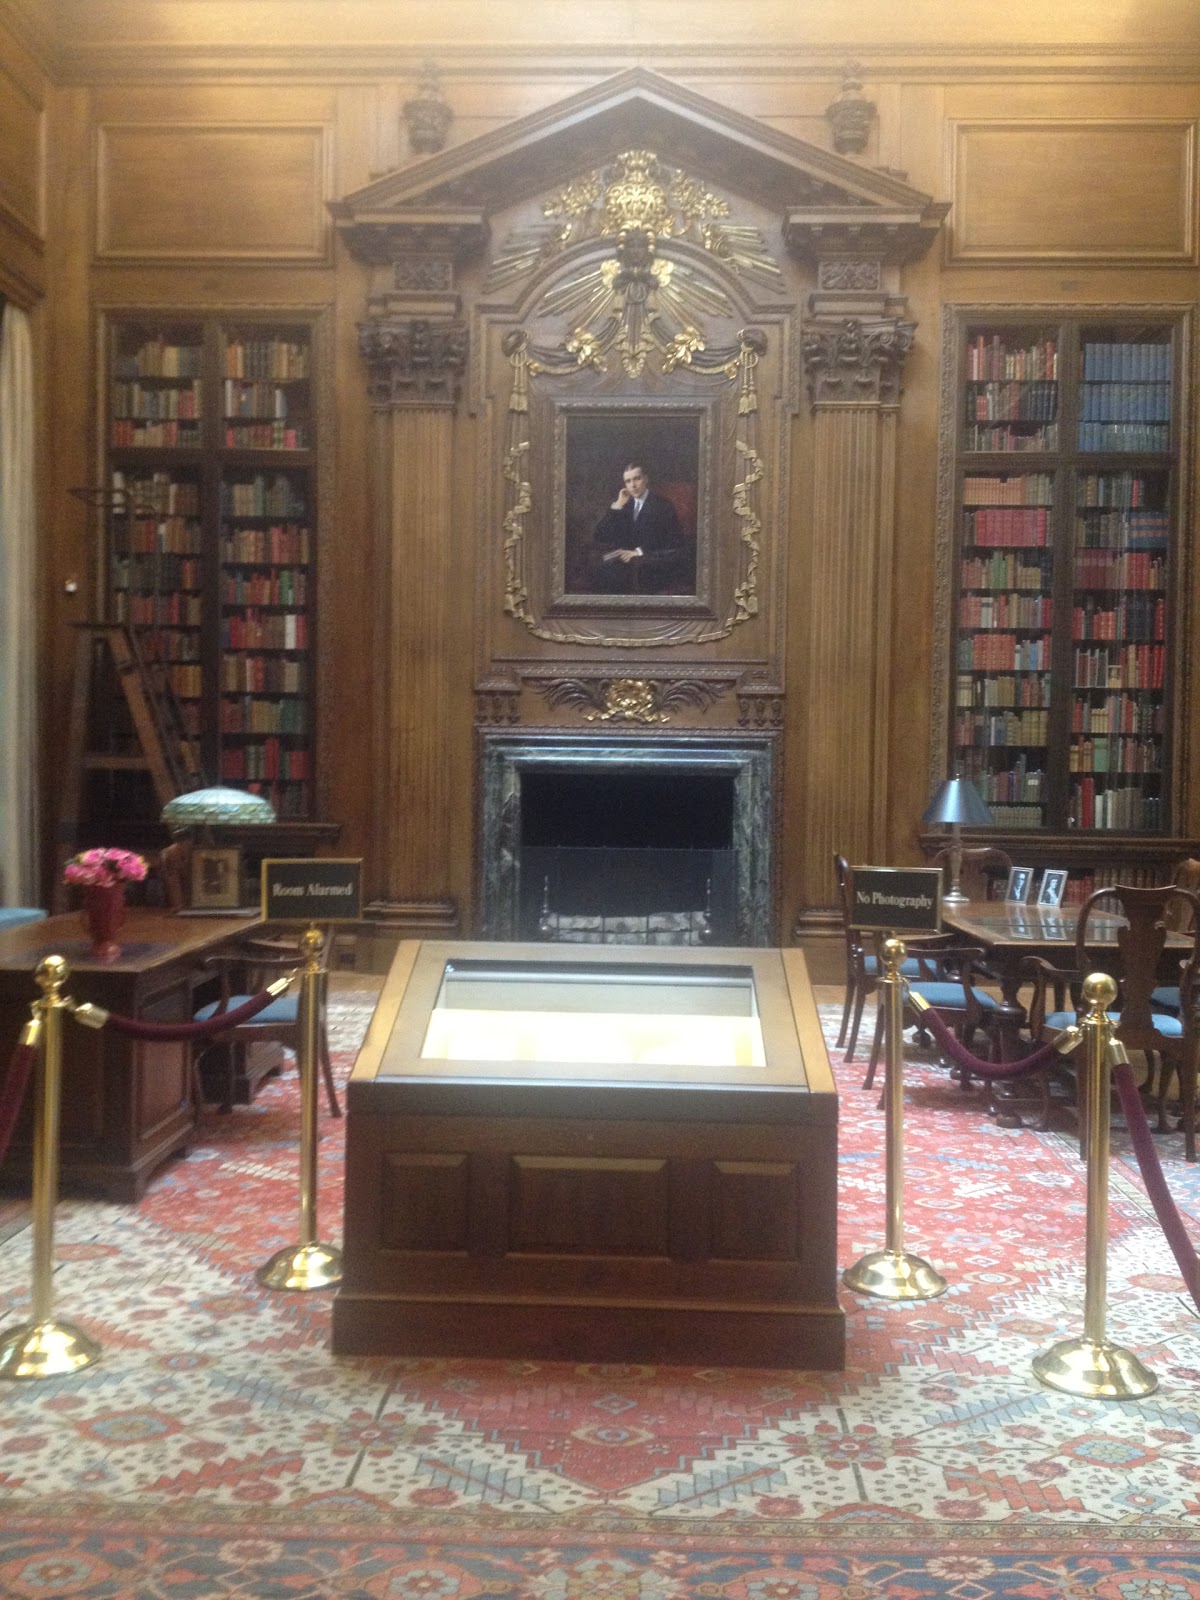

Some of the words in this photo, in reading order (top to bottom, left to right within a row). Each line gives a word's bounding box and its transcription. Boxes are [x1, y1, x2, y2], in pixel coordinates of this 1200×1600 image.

[273, 883, 305, 896] Room
[306, 882, 353, 896] Alarmed
[857, 891, 870, 904] No
[872, 891, 933, 909] Photography
